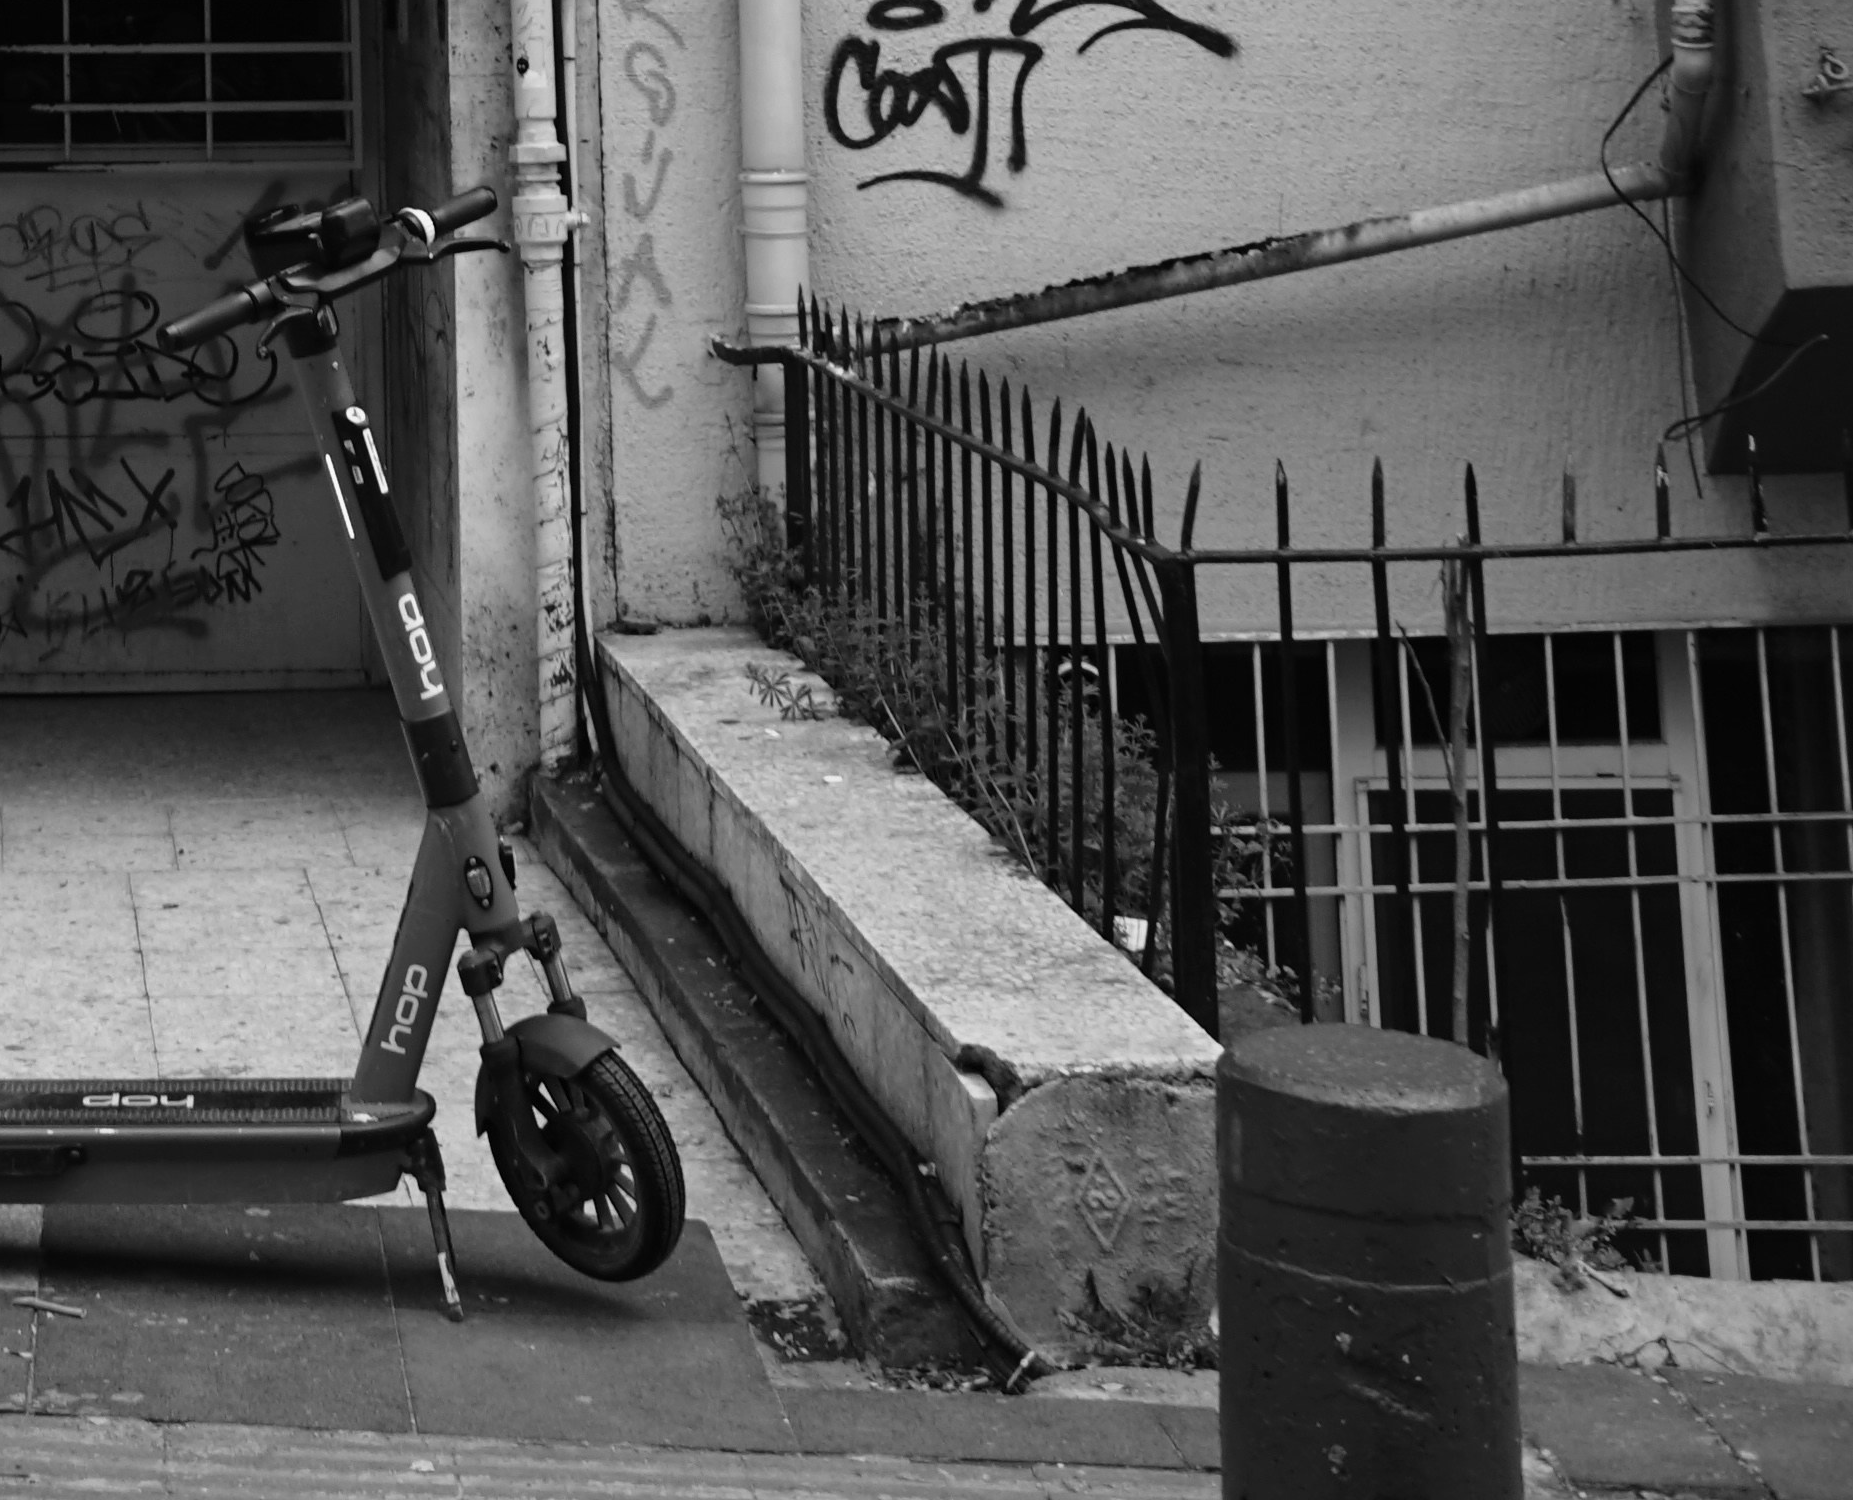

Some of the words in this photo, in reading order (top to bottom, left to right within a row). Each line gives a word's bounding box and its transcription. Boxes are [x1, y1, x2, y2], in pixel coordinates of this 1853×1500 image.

[397, 591, 444, 700] hop
[380, 964, 429, 1055] hop
[82, 1092, 195, 1109] hop
